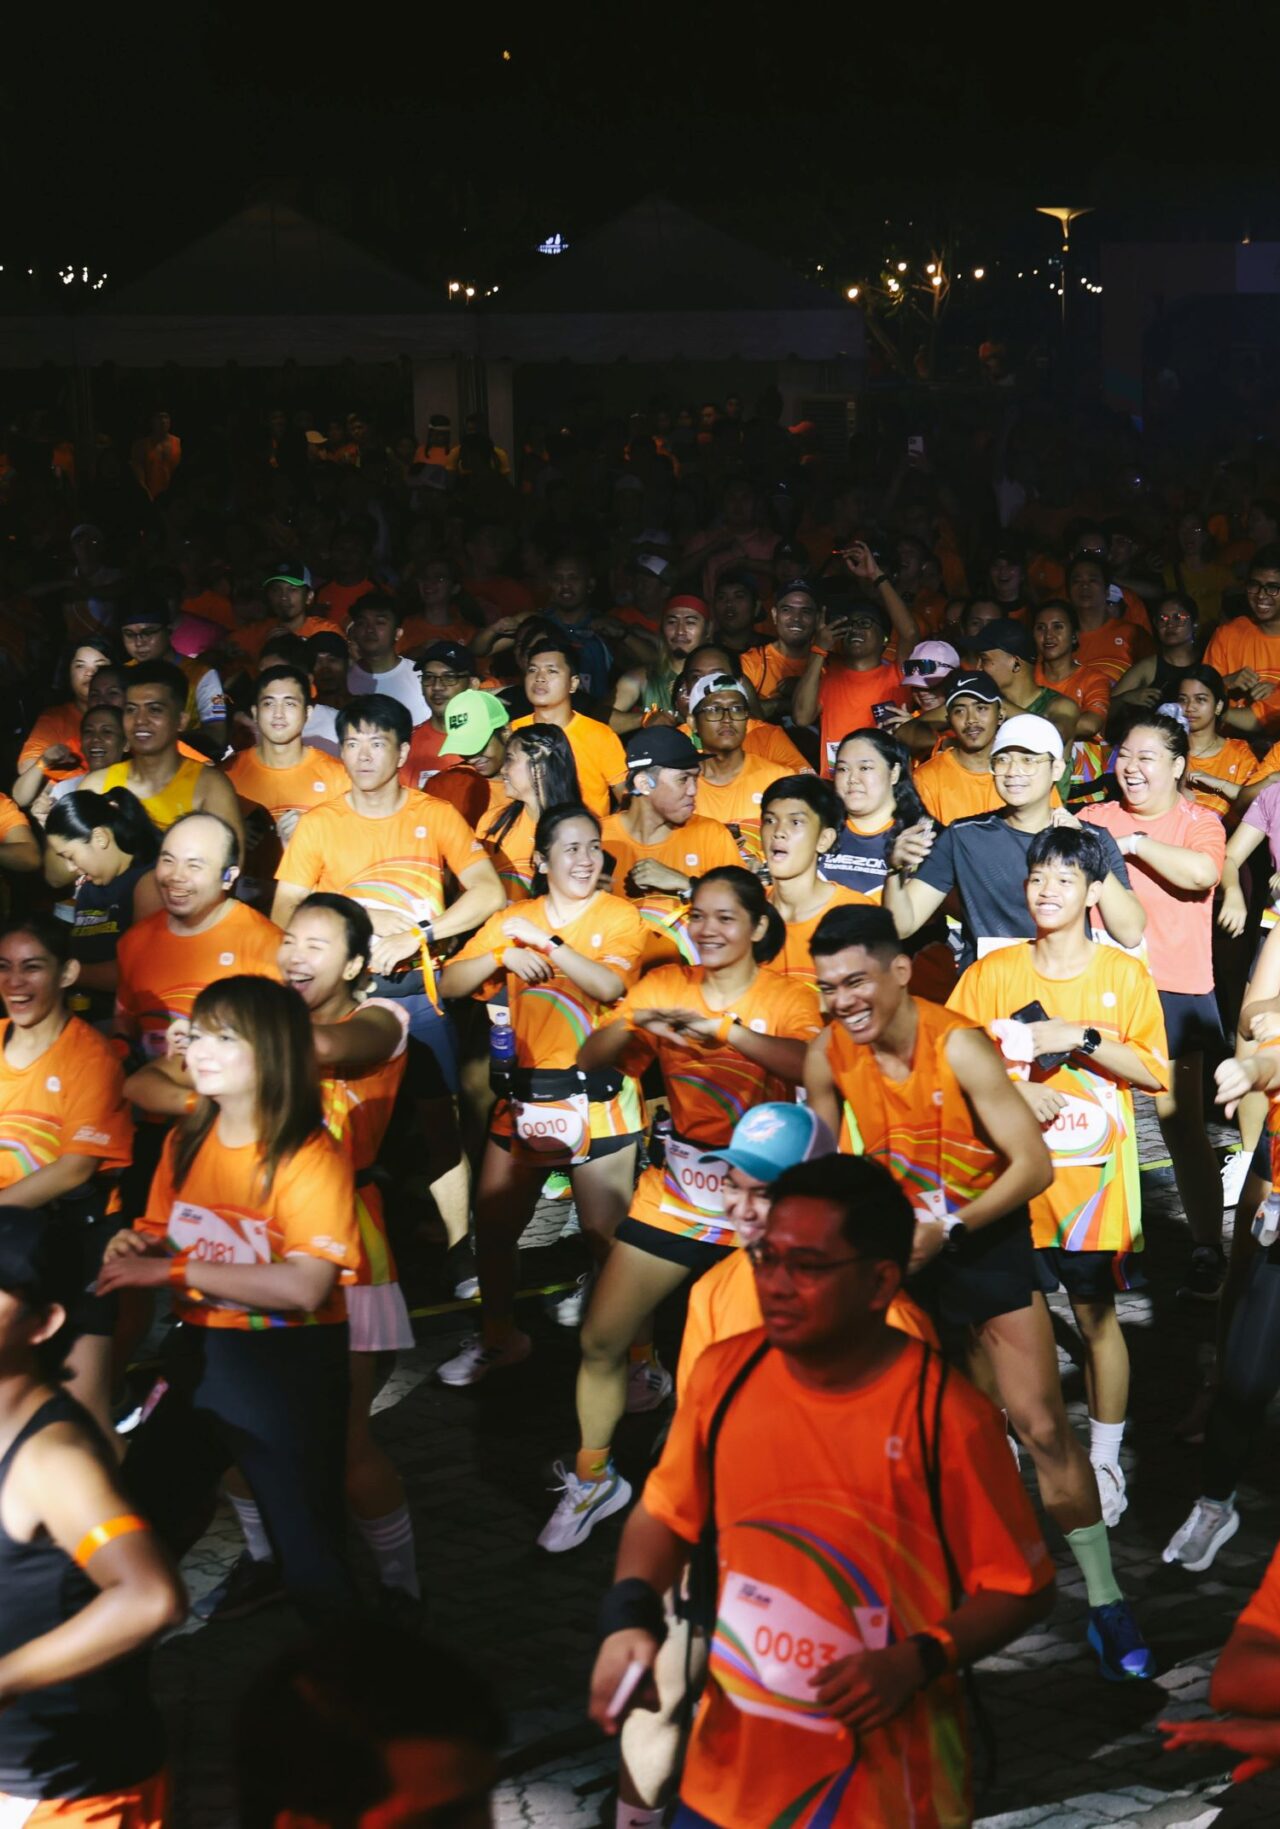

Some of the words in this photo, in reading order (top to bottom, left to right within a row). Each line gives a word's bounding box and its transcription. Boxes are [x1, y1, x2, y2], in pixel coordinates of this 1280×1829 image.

[521, 1118, 568, 1137] 0010
[1046, 1112, 1089, 1132] 014
[196, 1237, 236, 1264] 0181
[754, 1625, 837, 1670] 0083
